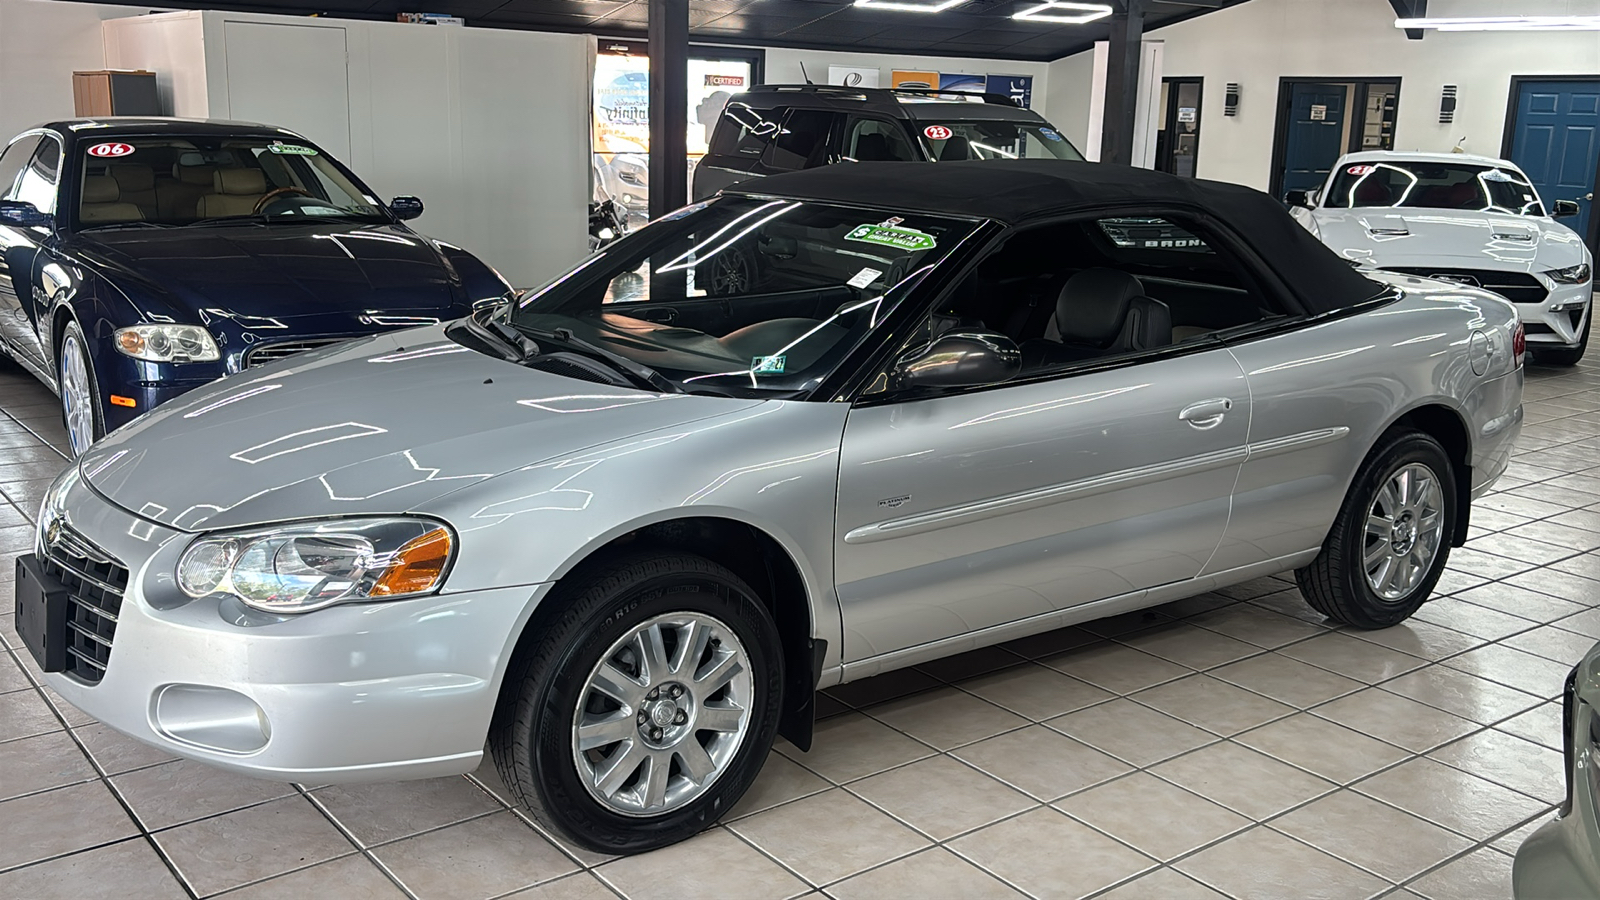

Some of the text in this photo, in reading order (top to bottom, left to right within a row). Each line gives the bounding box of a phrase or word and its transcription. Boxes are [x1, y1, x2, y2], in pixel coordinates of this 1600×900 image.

[713, 77, 742, 85] CERTIFIED
[929, 127, 947, 138] 23
[97, 143, 122, 156] 06
[867, 234, 919, 248] GREAT VALUE
[873, 229, 925, 243] CARFAX
[1145, 239, 1207, 248] BRON
[879, 496, 910, 506] PLATINUM
[615, 600, 638, 620] R16
